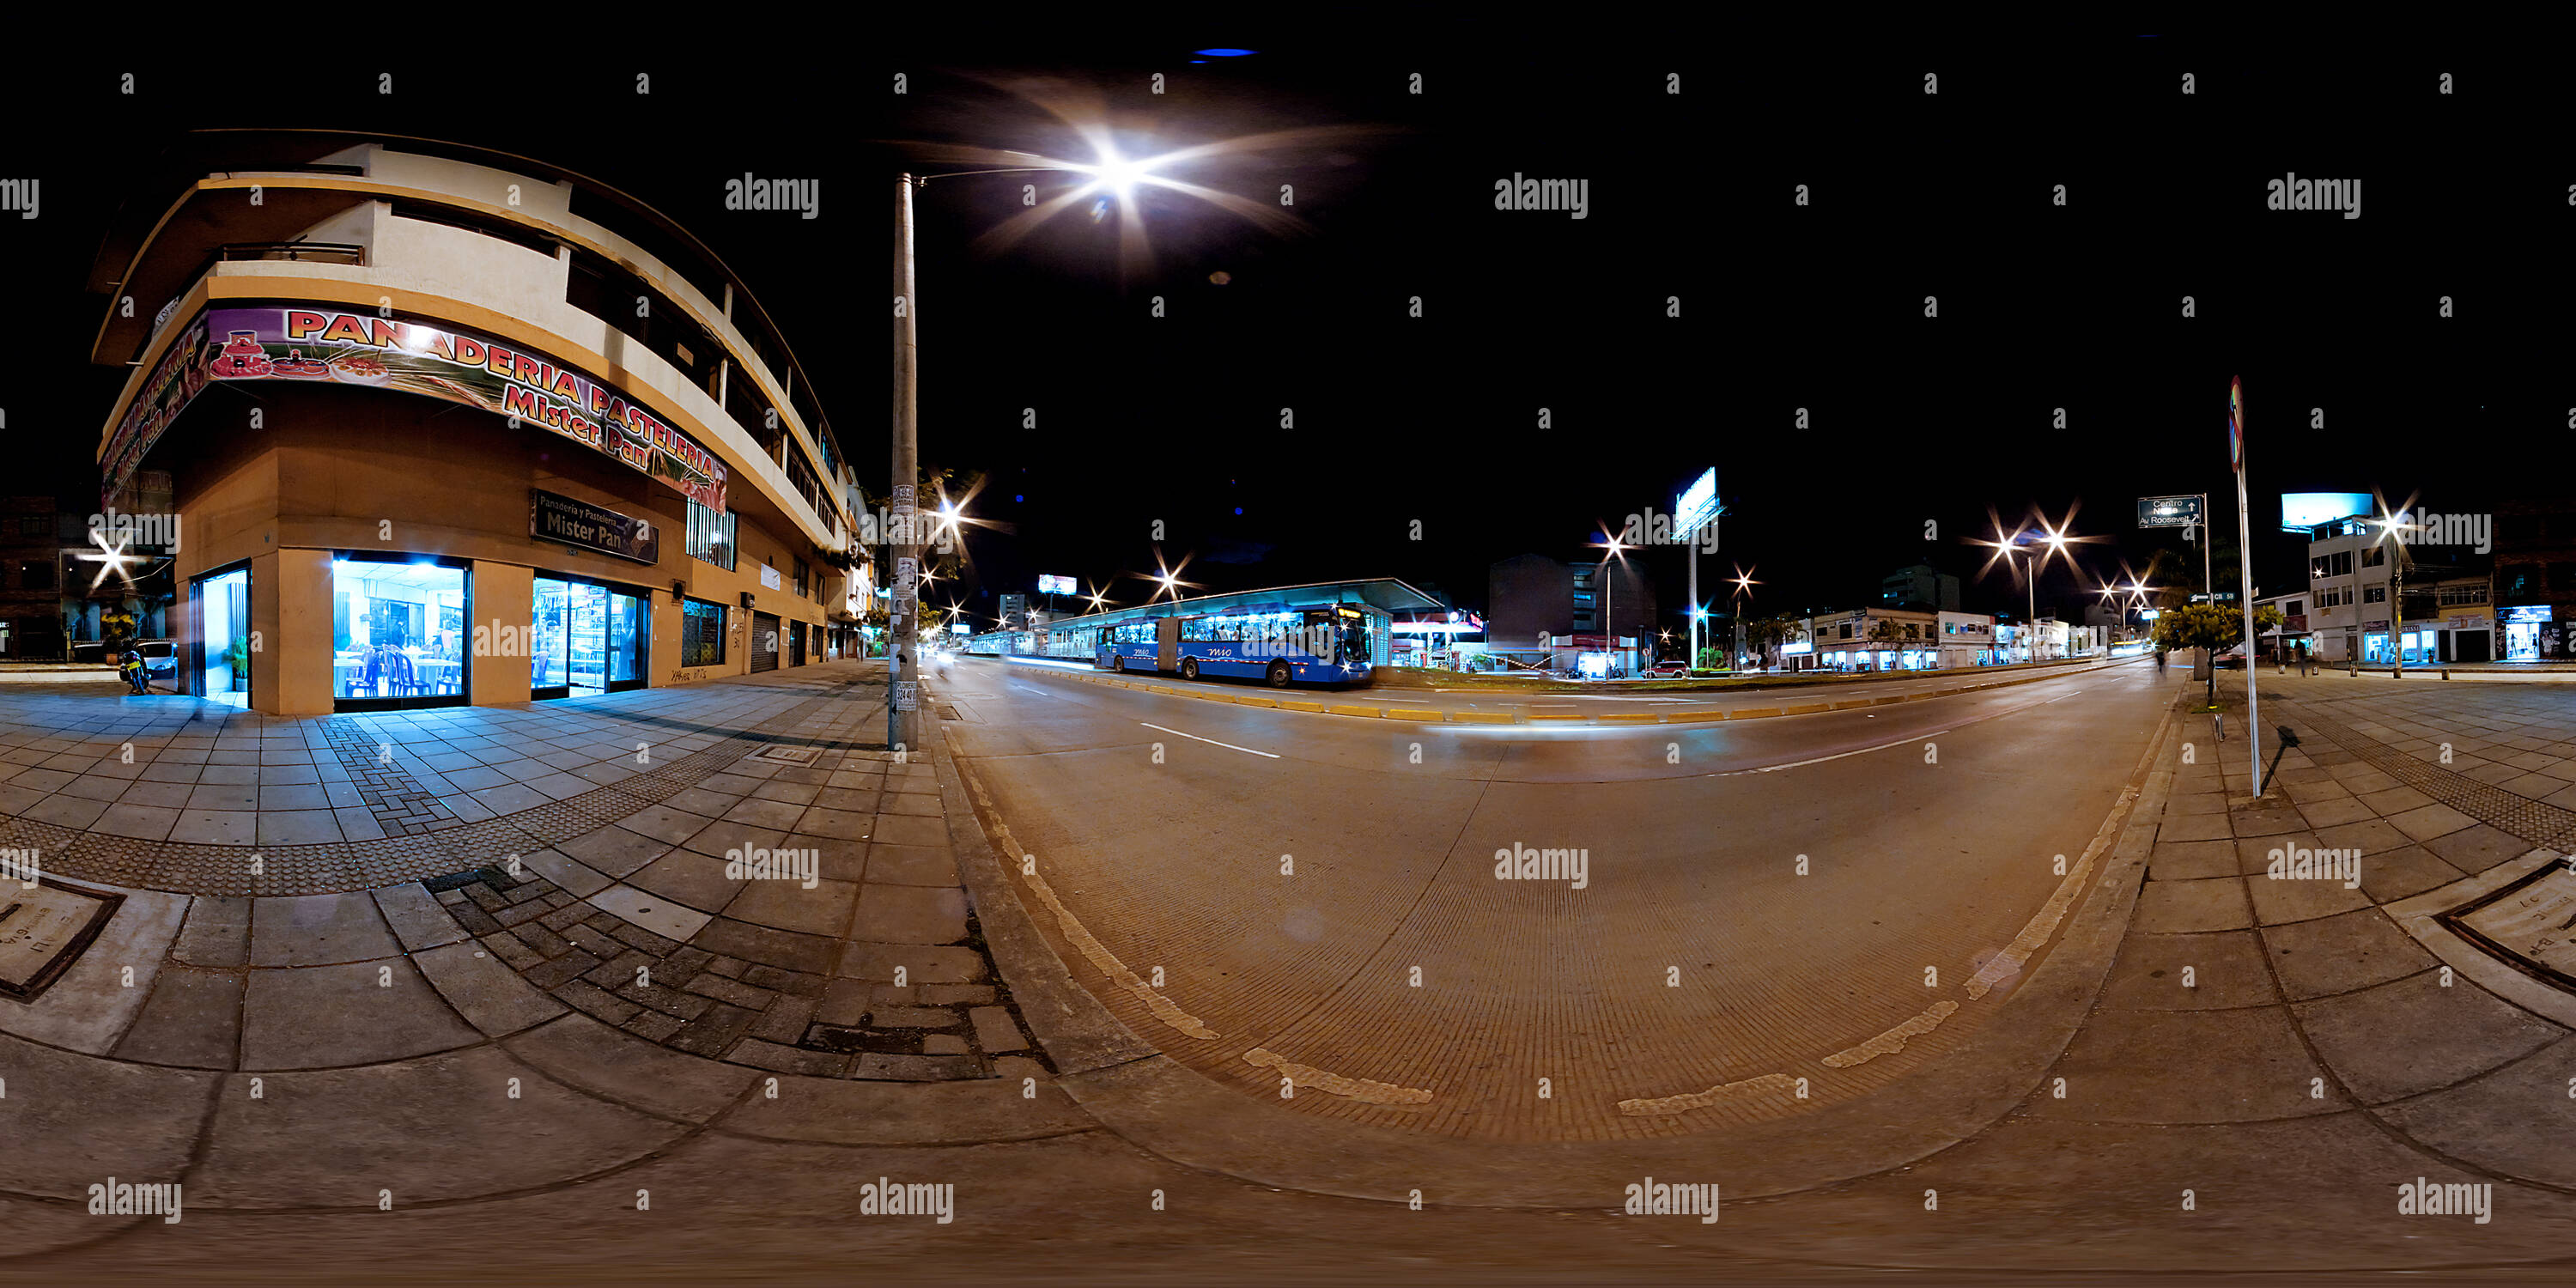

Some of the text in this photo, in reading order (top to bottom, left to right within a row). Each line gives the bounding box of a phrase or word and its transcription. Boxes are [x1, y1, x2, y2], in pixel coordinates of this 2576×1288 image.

[504, 384, 647, 469] Mister Pan
[590, 384, 716, 482] PASTELERIA
[547, 512, 622, 550] Mister Pan
